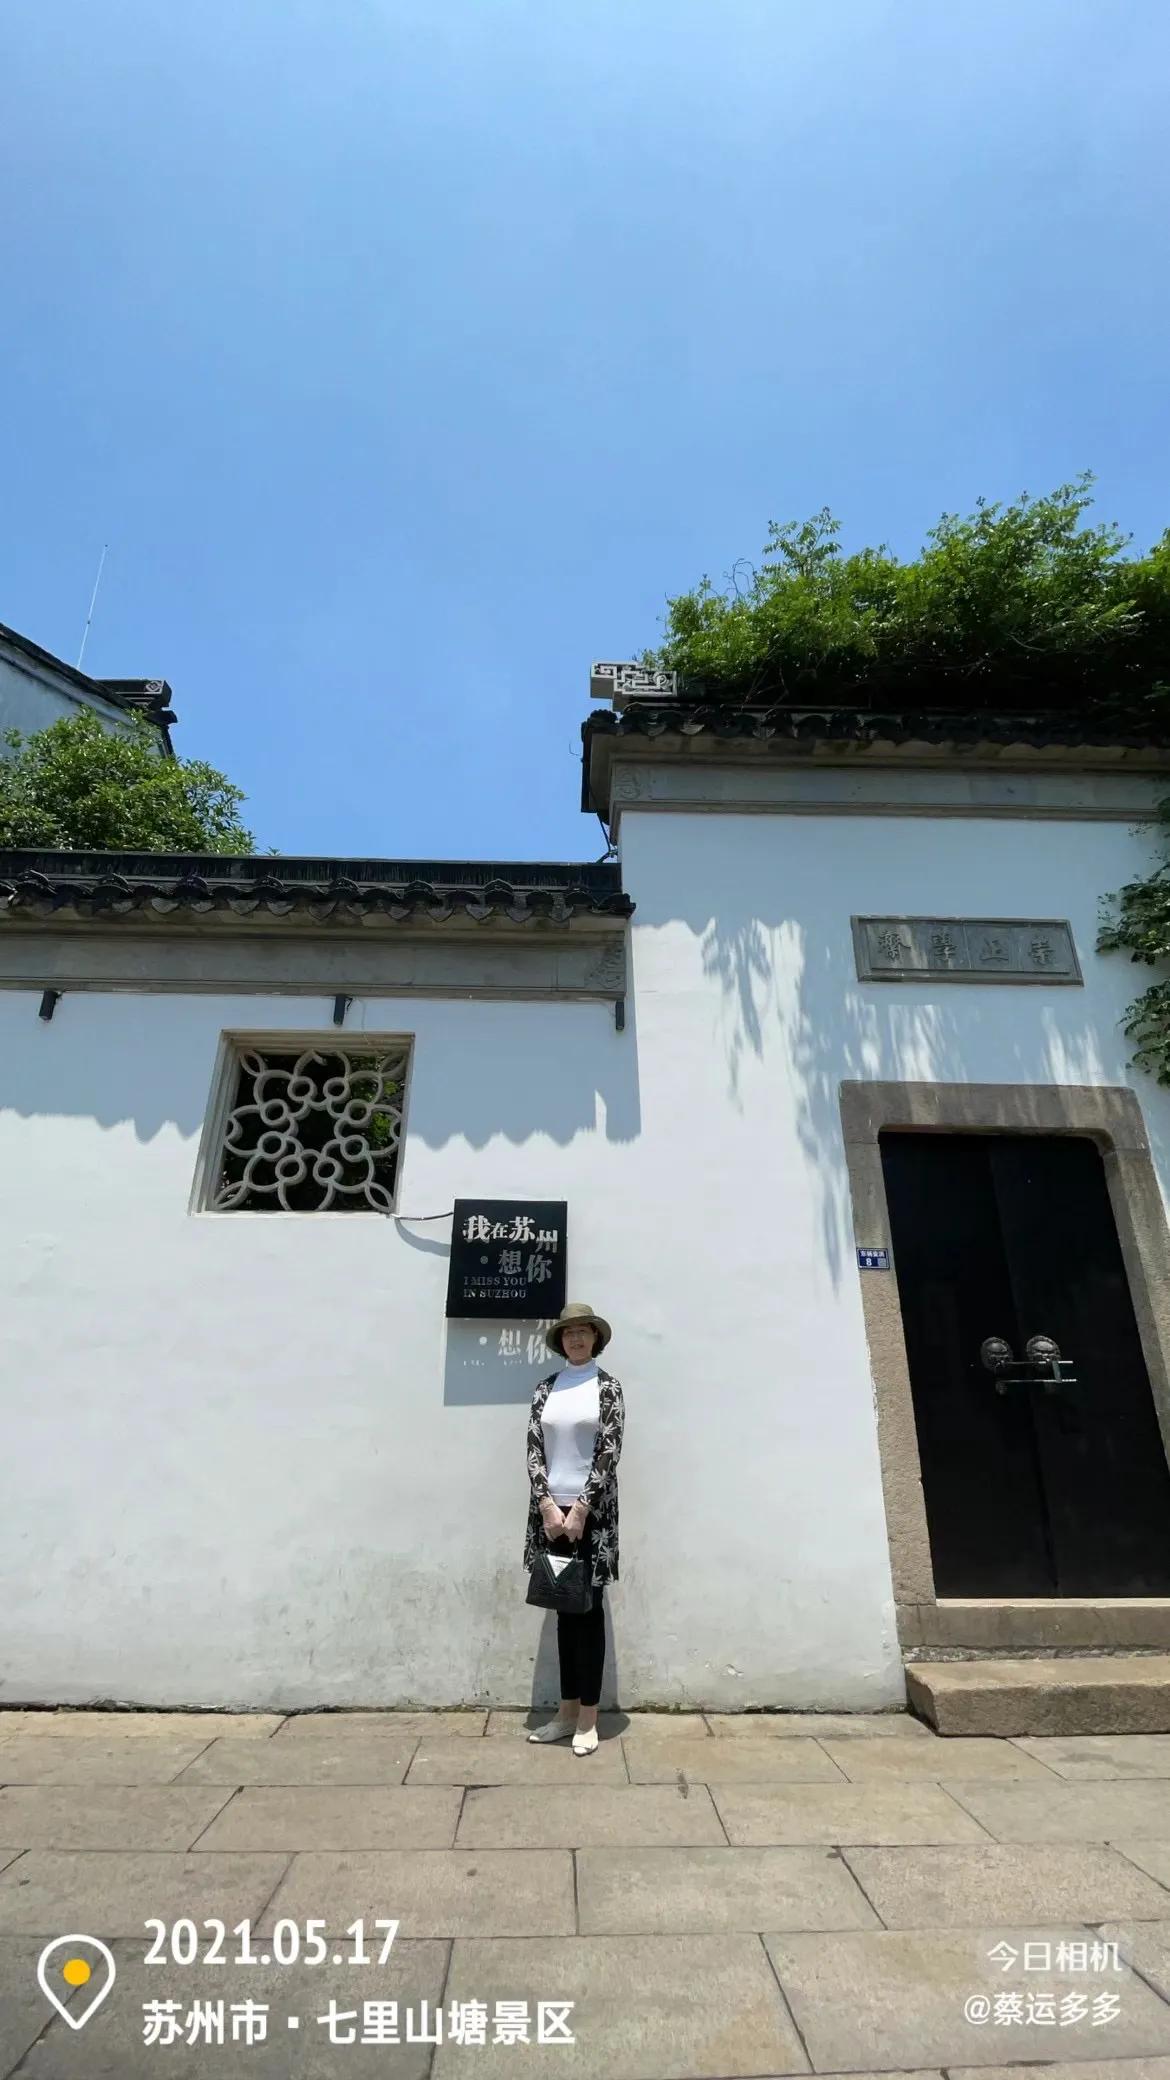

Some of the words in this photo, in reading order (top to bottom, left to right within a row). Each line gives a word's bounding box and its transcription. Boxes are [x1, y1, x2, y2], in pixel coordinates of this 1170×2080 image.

[463, 1215, 558, 1253] 我在苏州
[866, 1258, 872, 1266] 8
[471, 1276, 500, 1286] MISS
[503, 1276, 527, 1286] YOU
[464, 1288, 476, 1298] IN
[480, 1288, 527, 1298] SUZHOU
